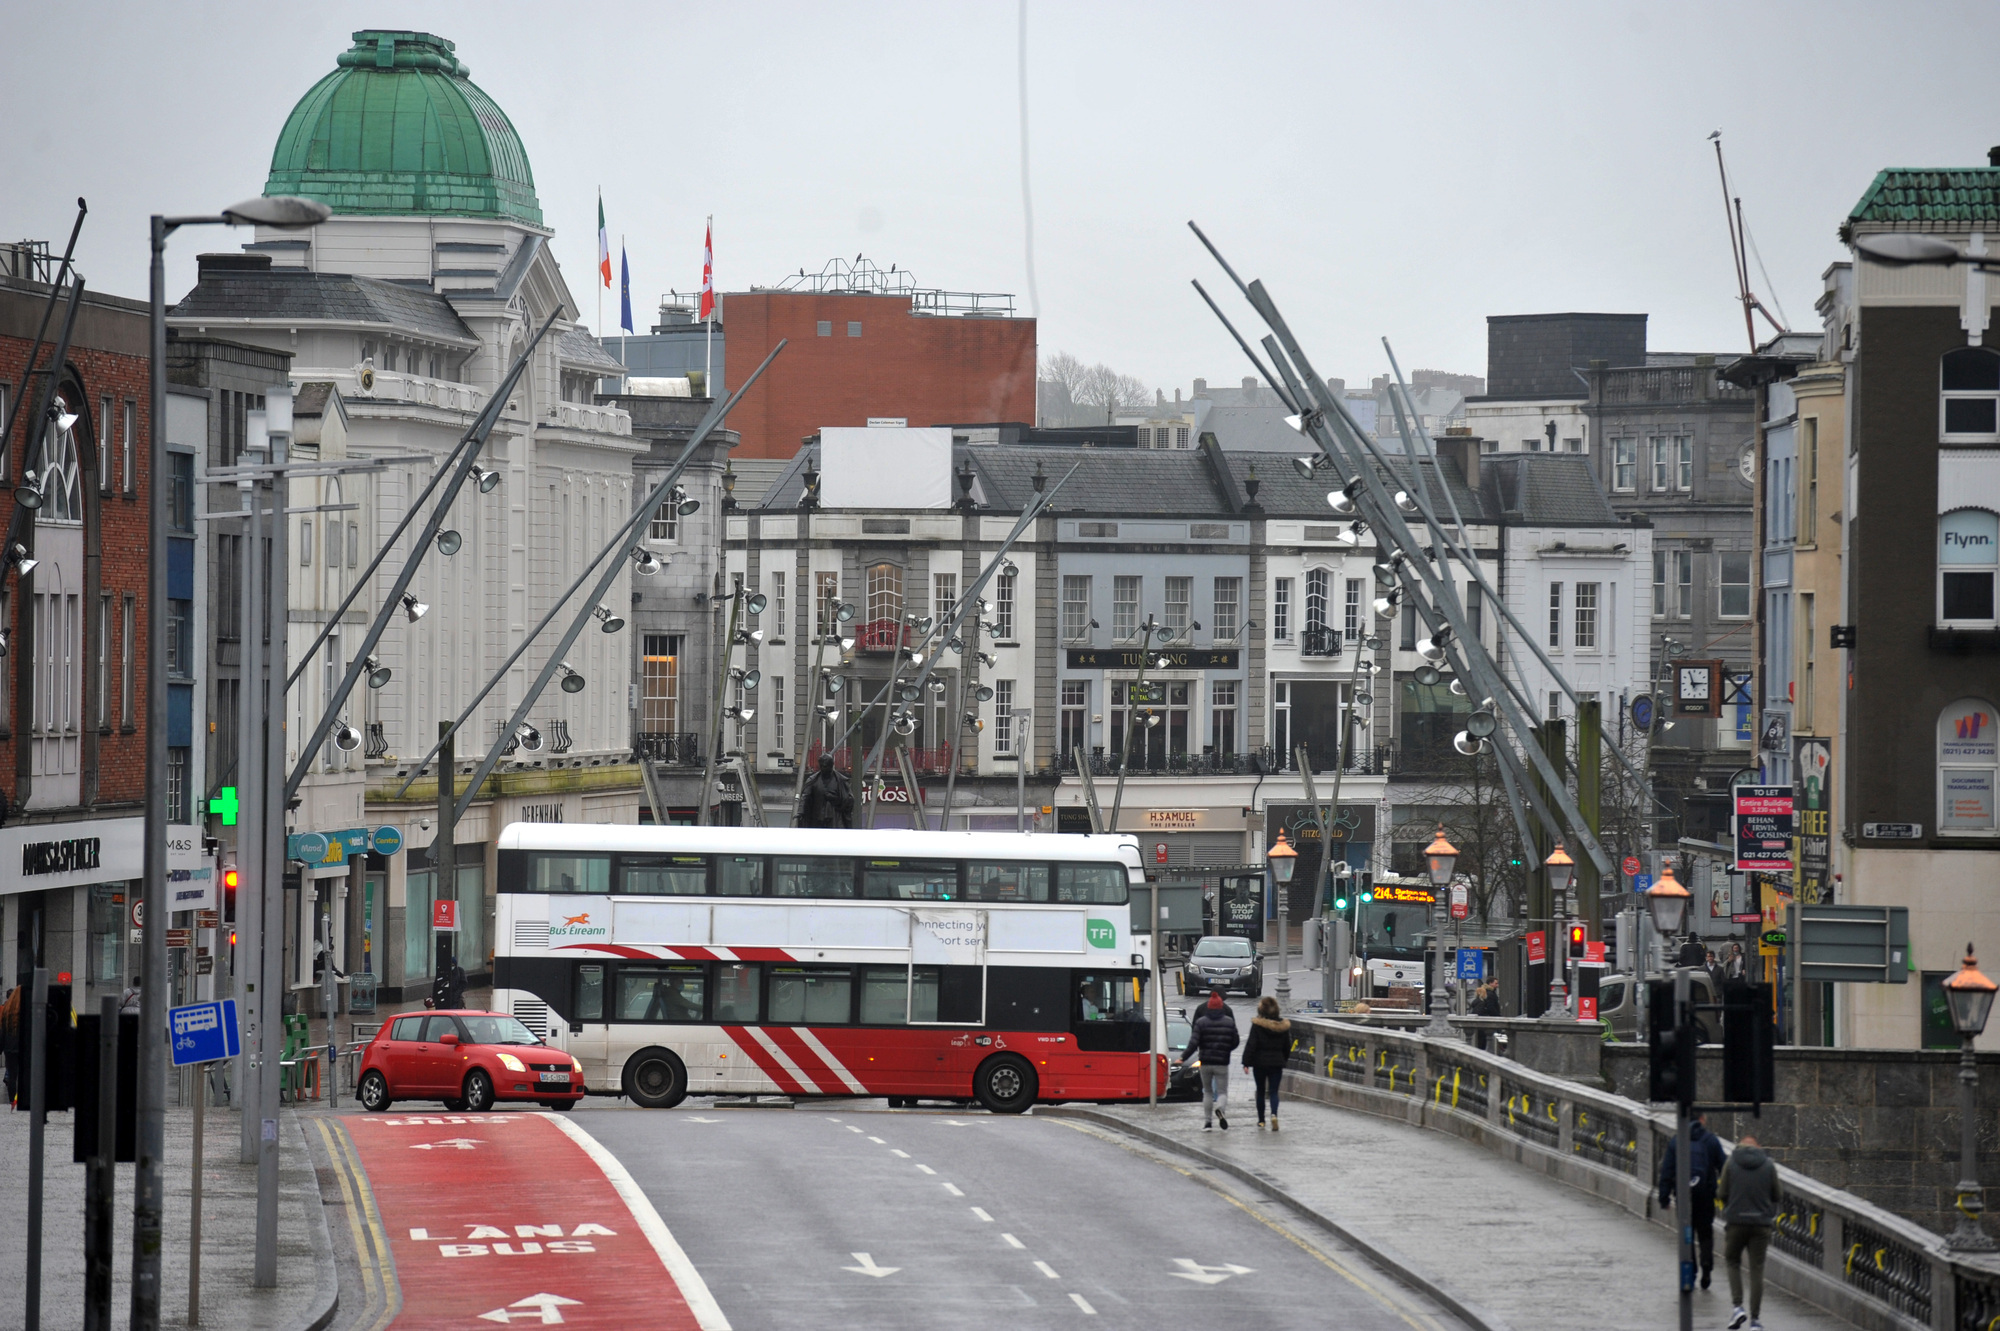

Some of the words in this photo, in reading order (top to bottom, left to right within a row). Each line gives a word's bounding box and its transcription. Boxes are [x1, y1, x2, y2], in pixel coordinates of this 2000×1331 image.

[1945, 532, 1993, 549] Flynn.
[721, 793, 743, 801] AMBERS
[1763, 800, 1793, 808] Building
[522, 803, 562, 823] DEBENHAMS
[1801, 810, 1828, 835] FREE
[1301, 829, 1343, 838] FITZGLD
[1741, 824, 1755, 839] &
[167, 839, 191, 850] M&S
[1802, 837, 1827, 856] T-Shirt
[550, 926, 567, 935] Bus
[1090, 928, 1113, 940] TFI
[438, 1241, 596, 1257] BUS
